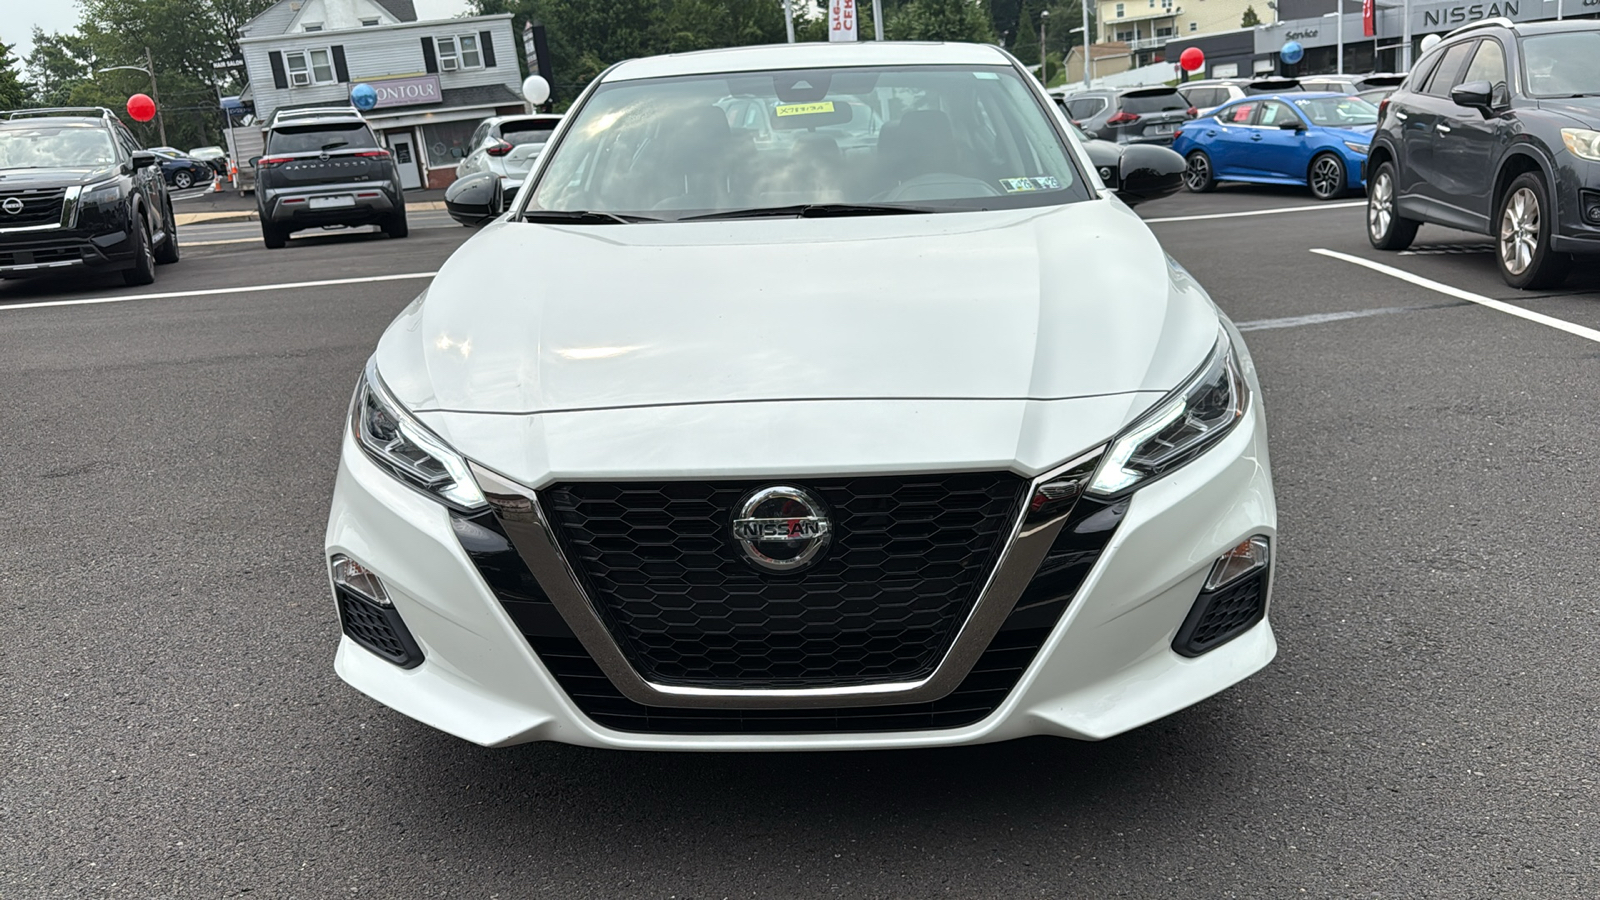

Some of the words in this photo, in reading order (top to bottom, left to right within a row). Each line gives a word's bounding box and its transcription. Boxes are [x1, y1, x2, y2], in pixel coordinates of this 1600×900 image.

[1424, 0, 1519, 26] NISSAN
[1285, 28, 1319, 41] Service
[375, 83, 435, 101] ONTOUR
[743, 522, 819, 536] NISSAN
